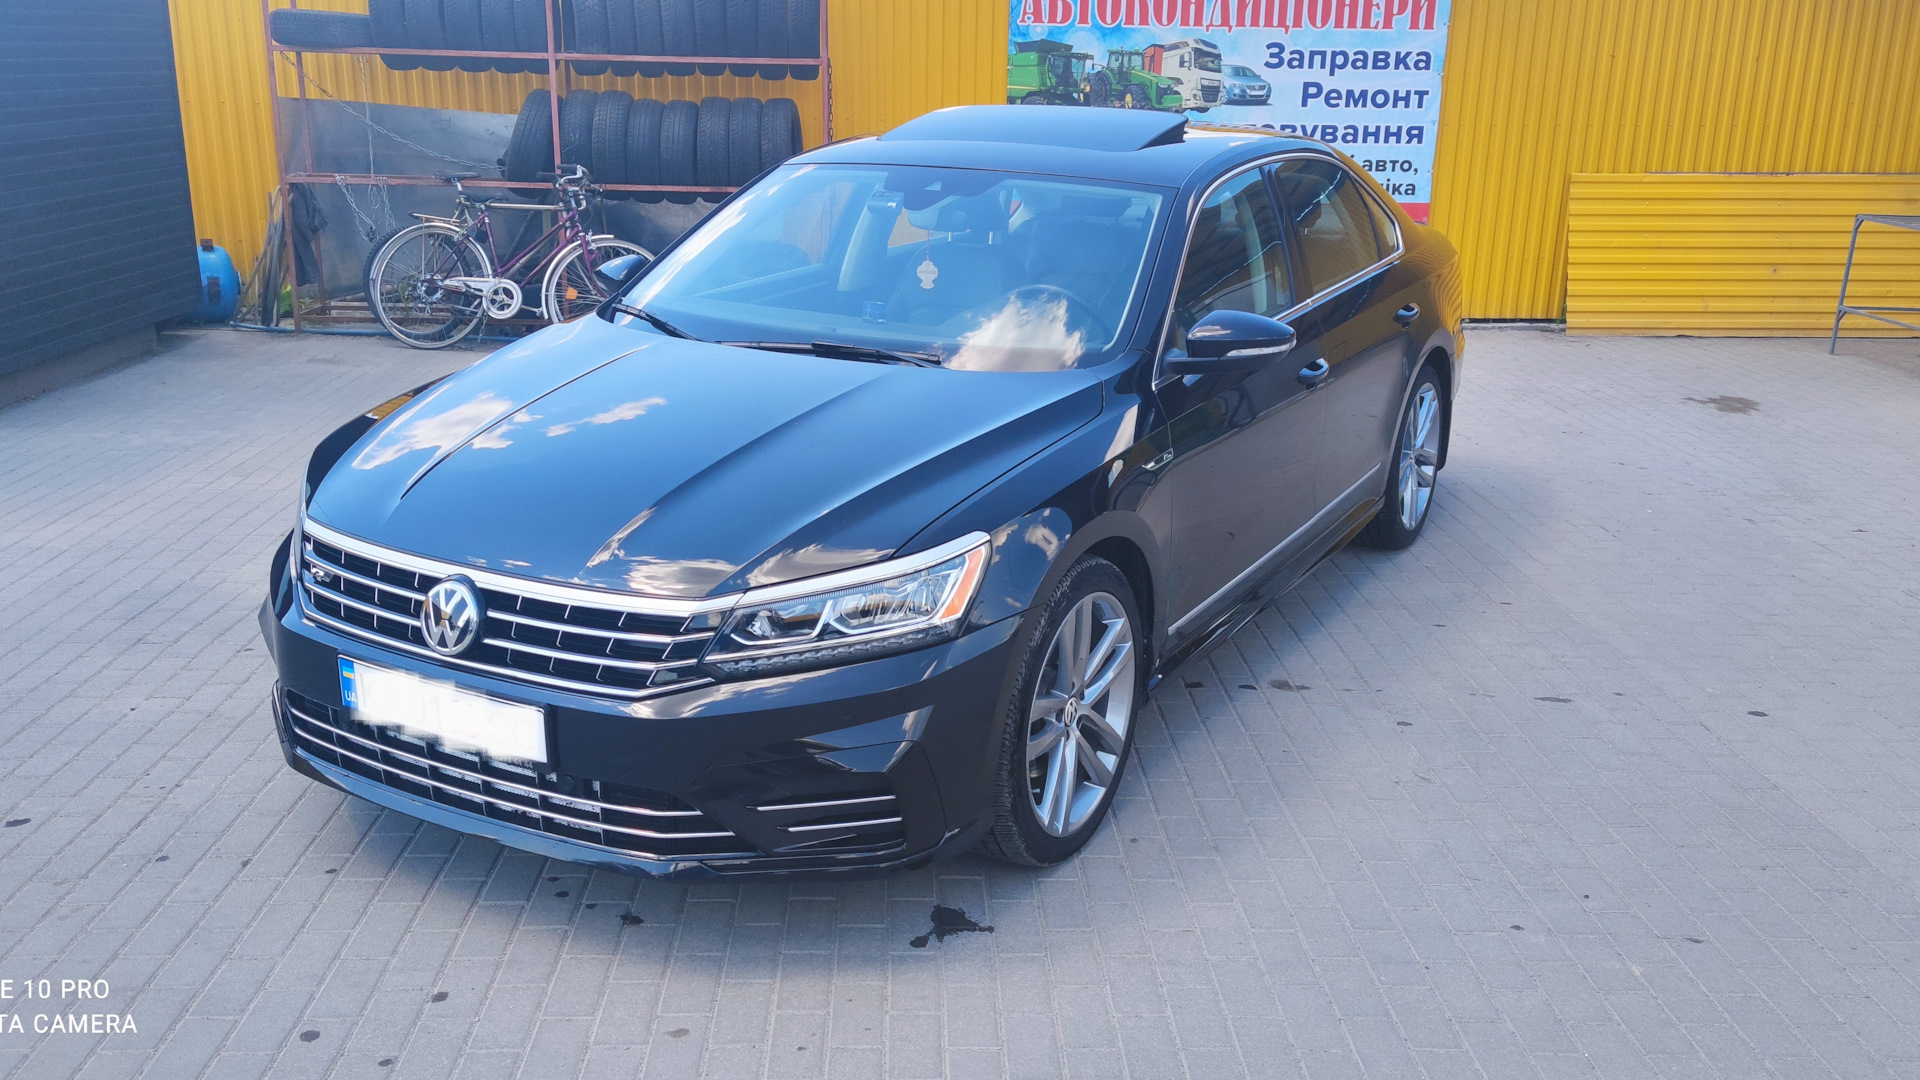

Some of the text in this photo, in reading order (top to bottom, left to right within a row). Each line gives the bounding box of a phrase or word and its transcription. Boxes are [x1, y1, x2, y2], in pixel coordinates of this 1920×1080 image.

[1264, 42, 1432, 77] Заправка
[1301, 81, 1430, 109] Ремонт
[1380, 177, 1417, 196] іка
[344, 689, 358, 704] UA
